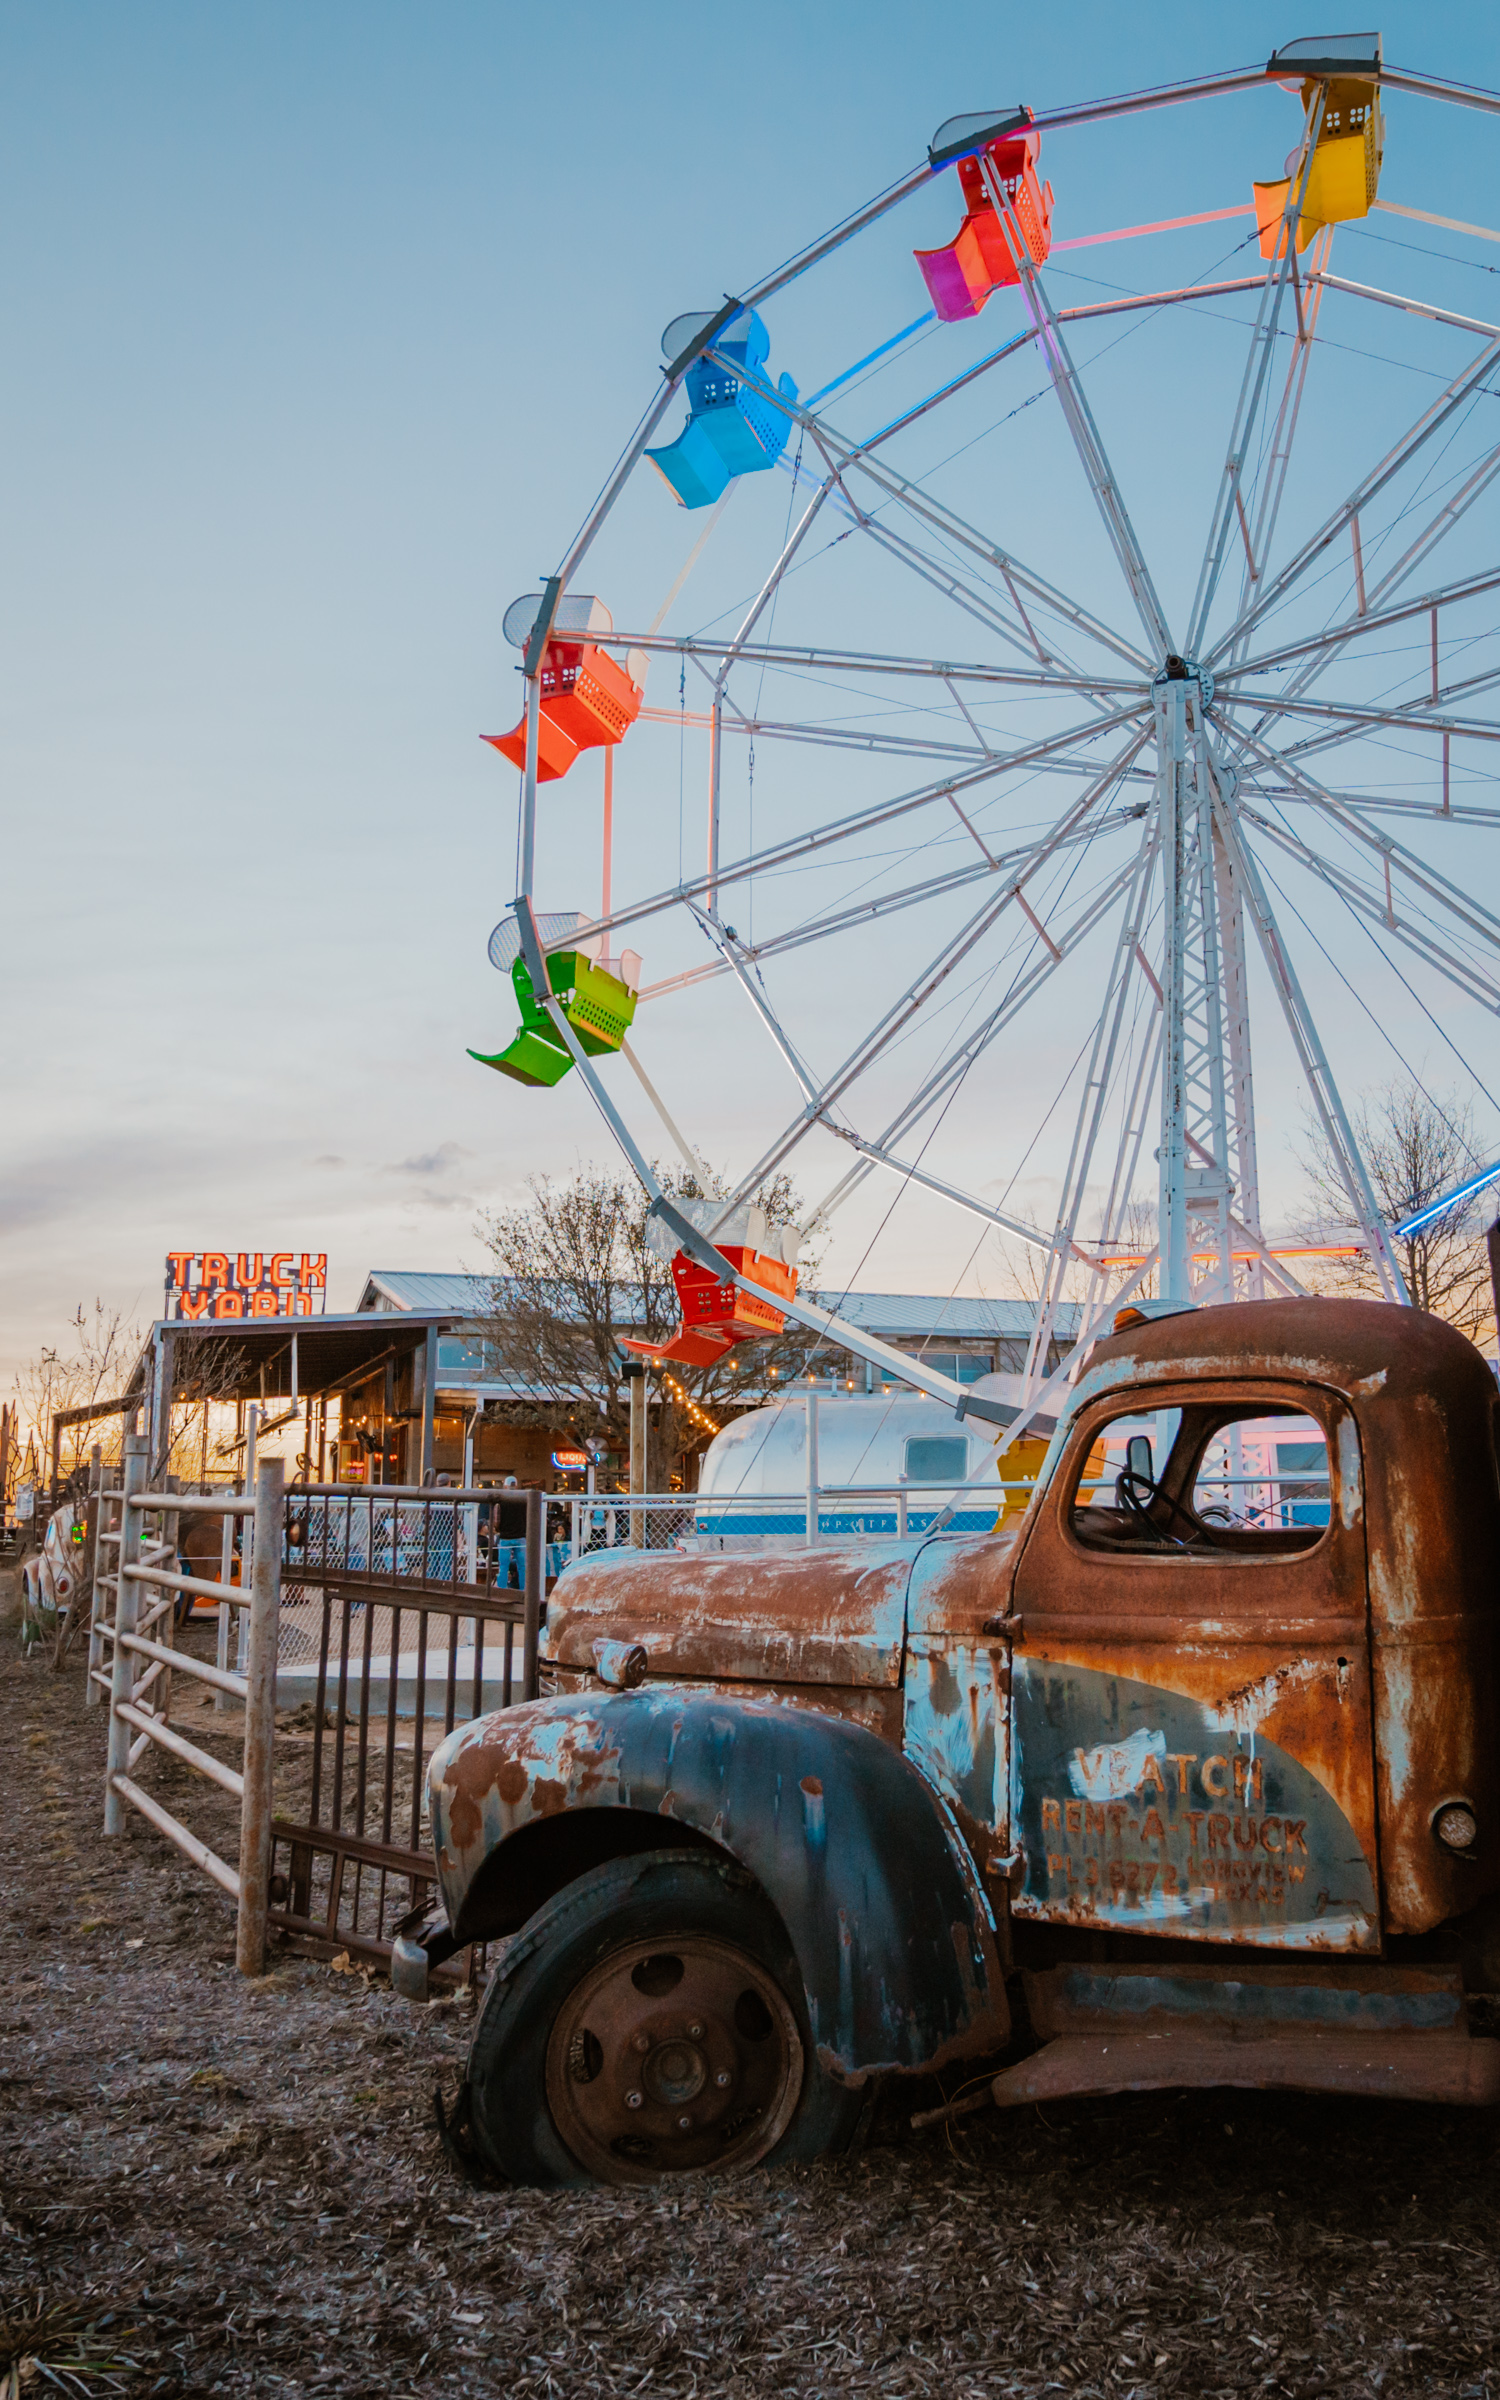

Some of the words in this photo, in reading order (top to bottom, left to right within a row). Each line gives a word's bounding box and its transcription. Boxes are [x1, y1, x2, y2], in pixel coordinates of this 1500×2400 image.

[168, 1252, 326, 1287] TRUCK
[1187, 1856, 1307, 1884] LONGVIEW
[1205, 1880, 1286, 1905] TEXAS
